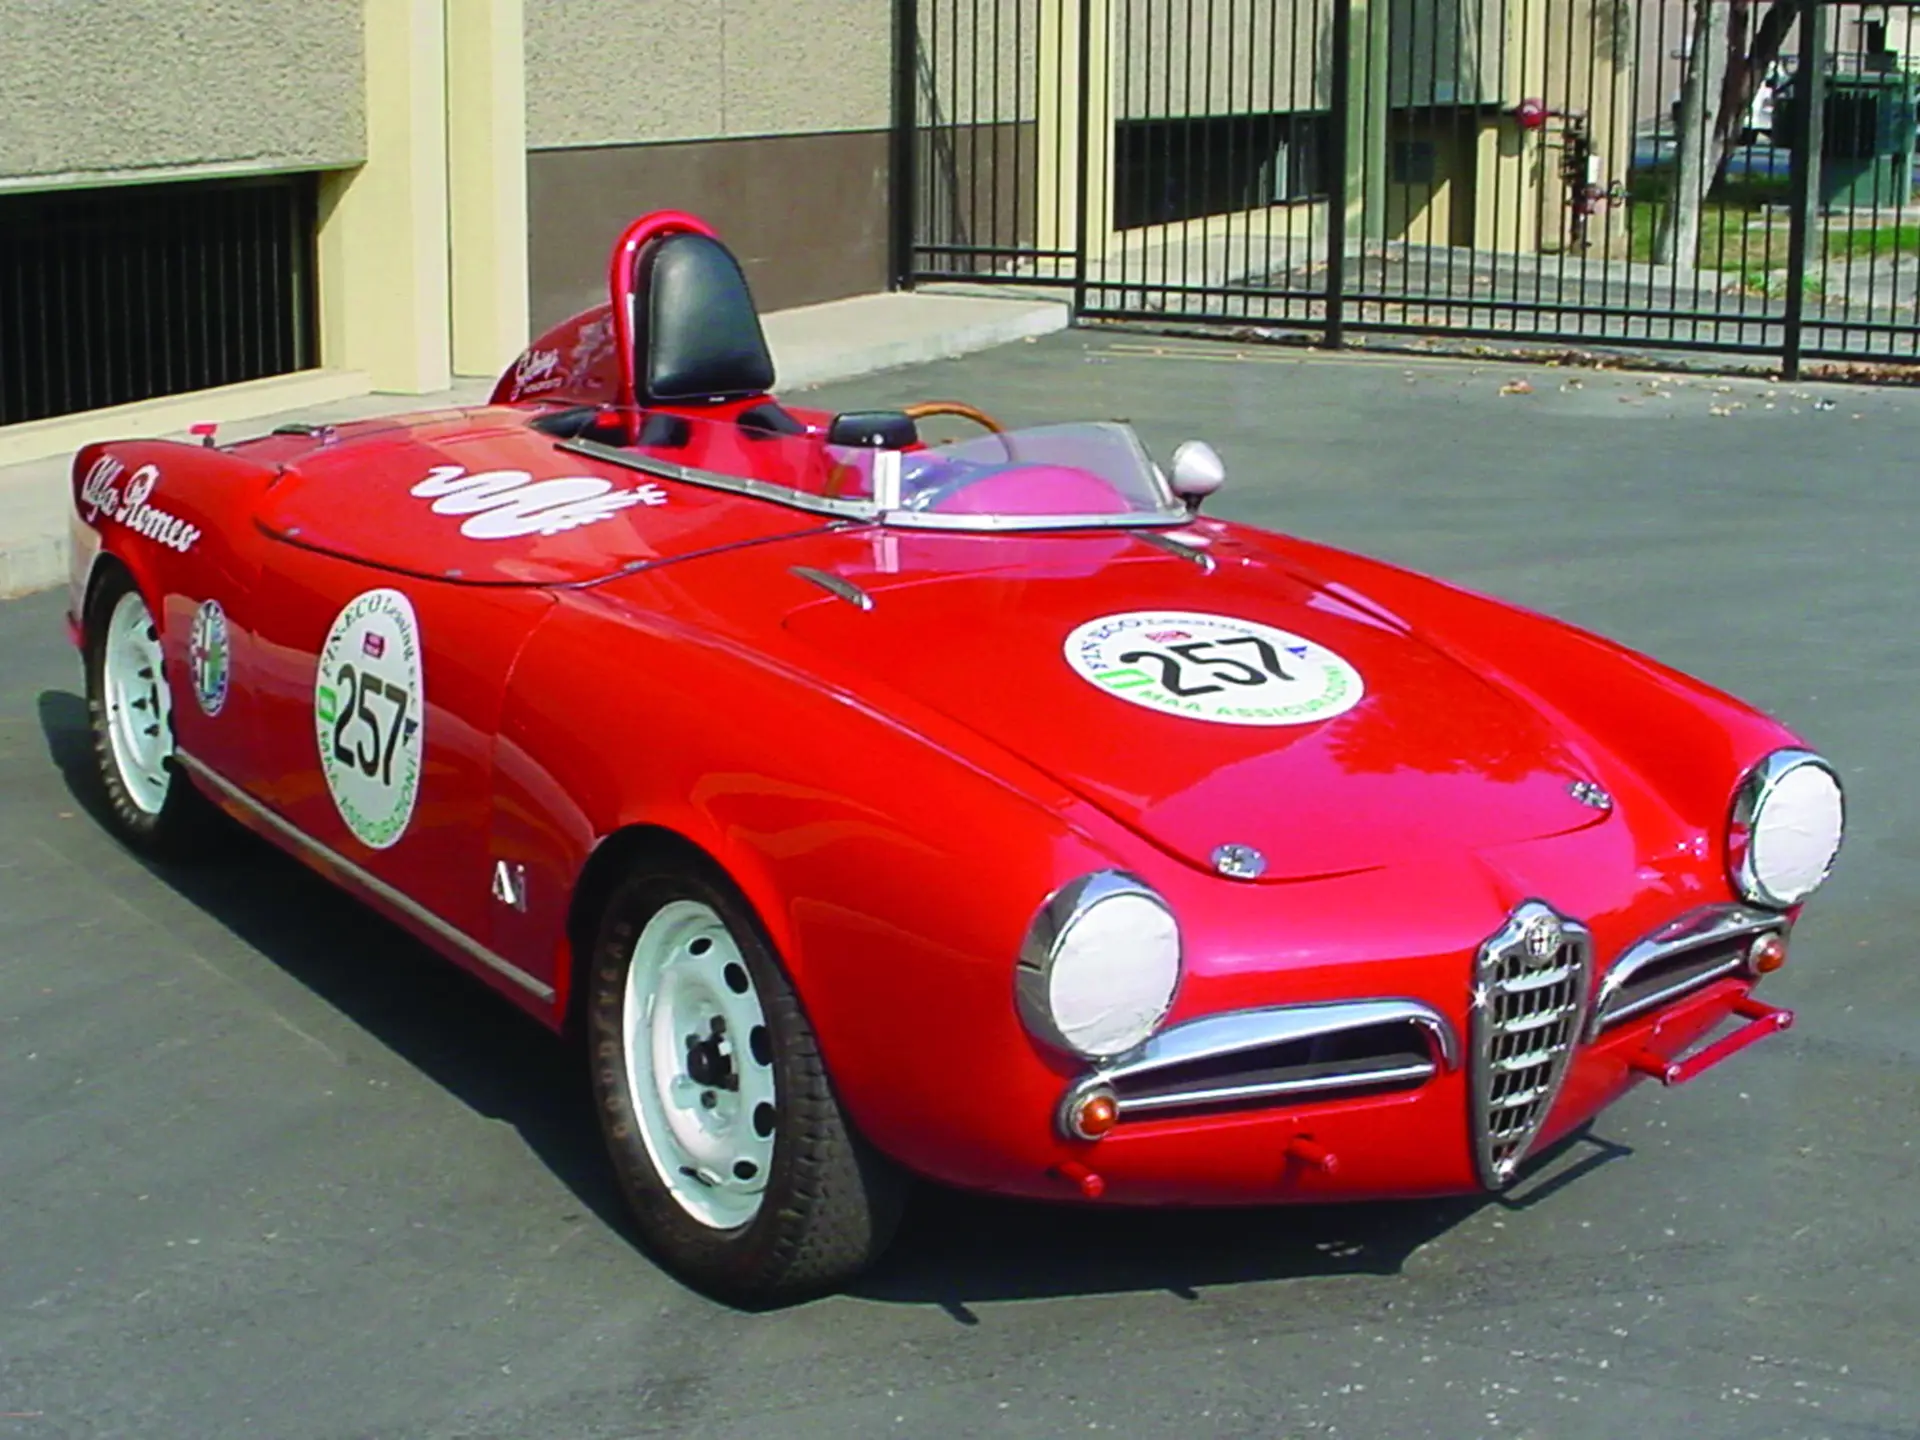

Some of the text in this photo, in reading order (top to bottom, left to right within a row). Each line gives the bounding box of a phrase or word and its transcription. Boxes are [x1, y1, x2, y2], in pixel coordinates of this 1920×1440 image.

[81, 453, 202, 552] Alfa Romeo
[1119, 636, 1296, 697] 257
[334, 663, 408, 787] 257
